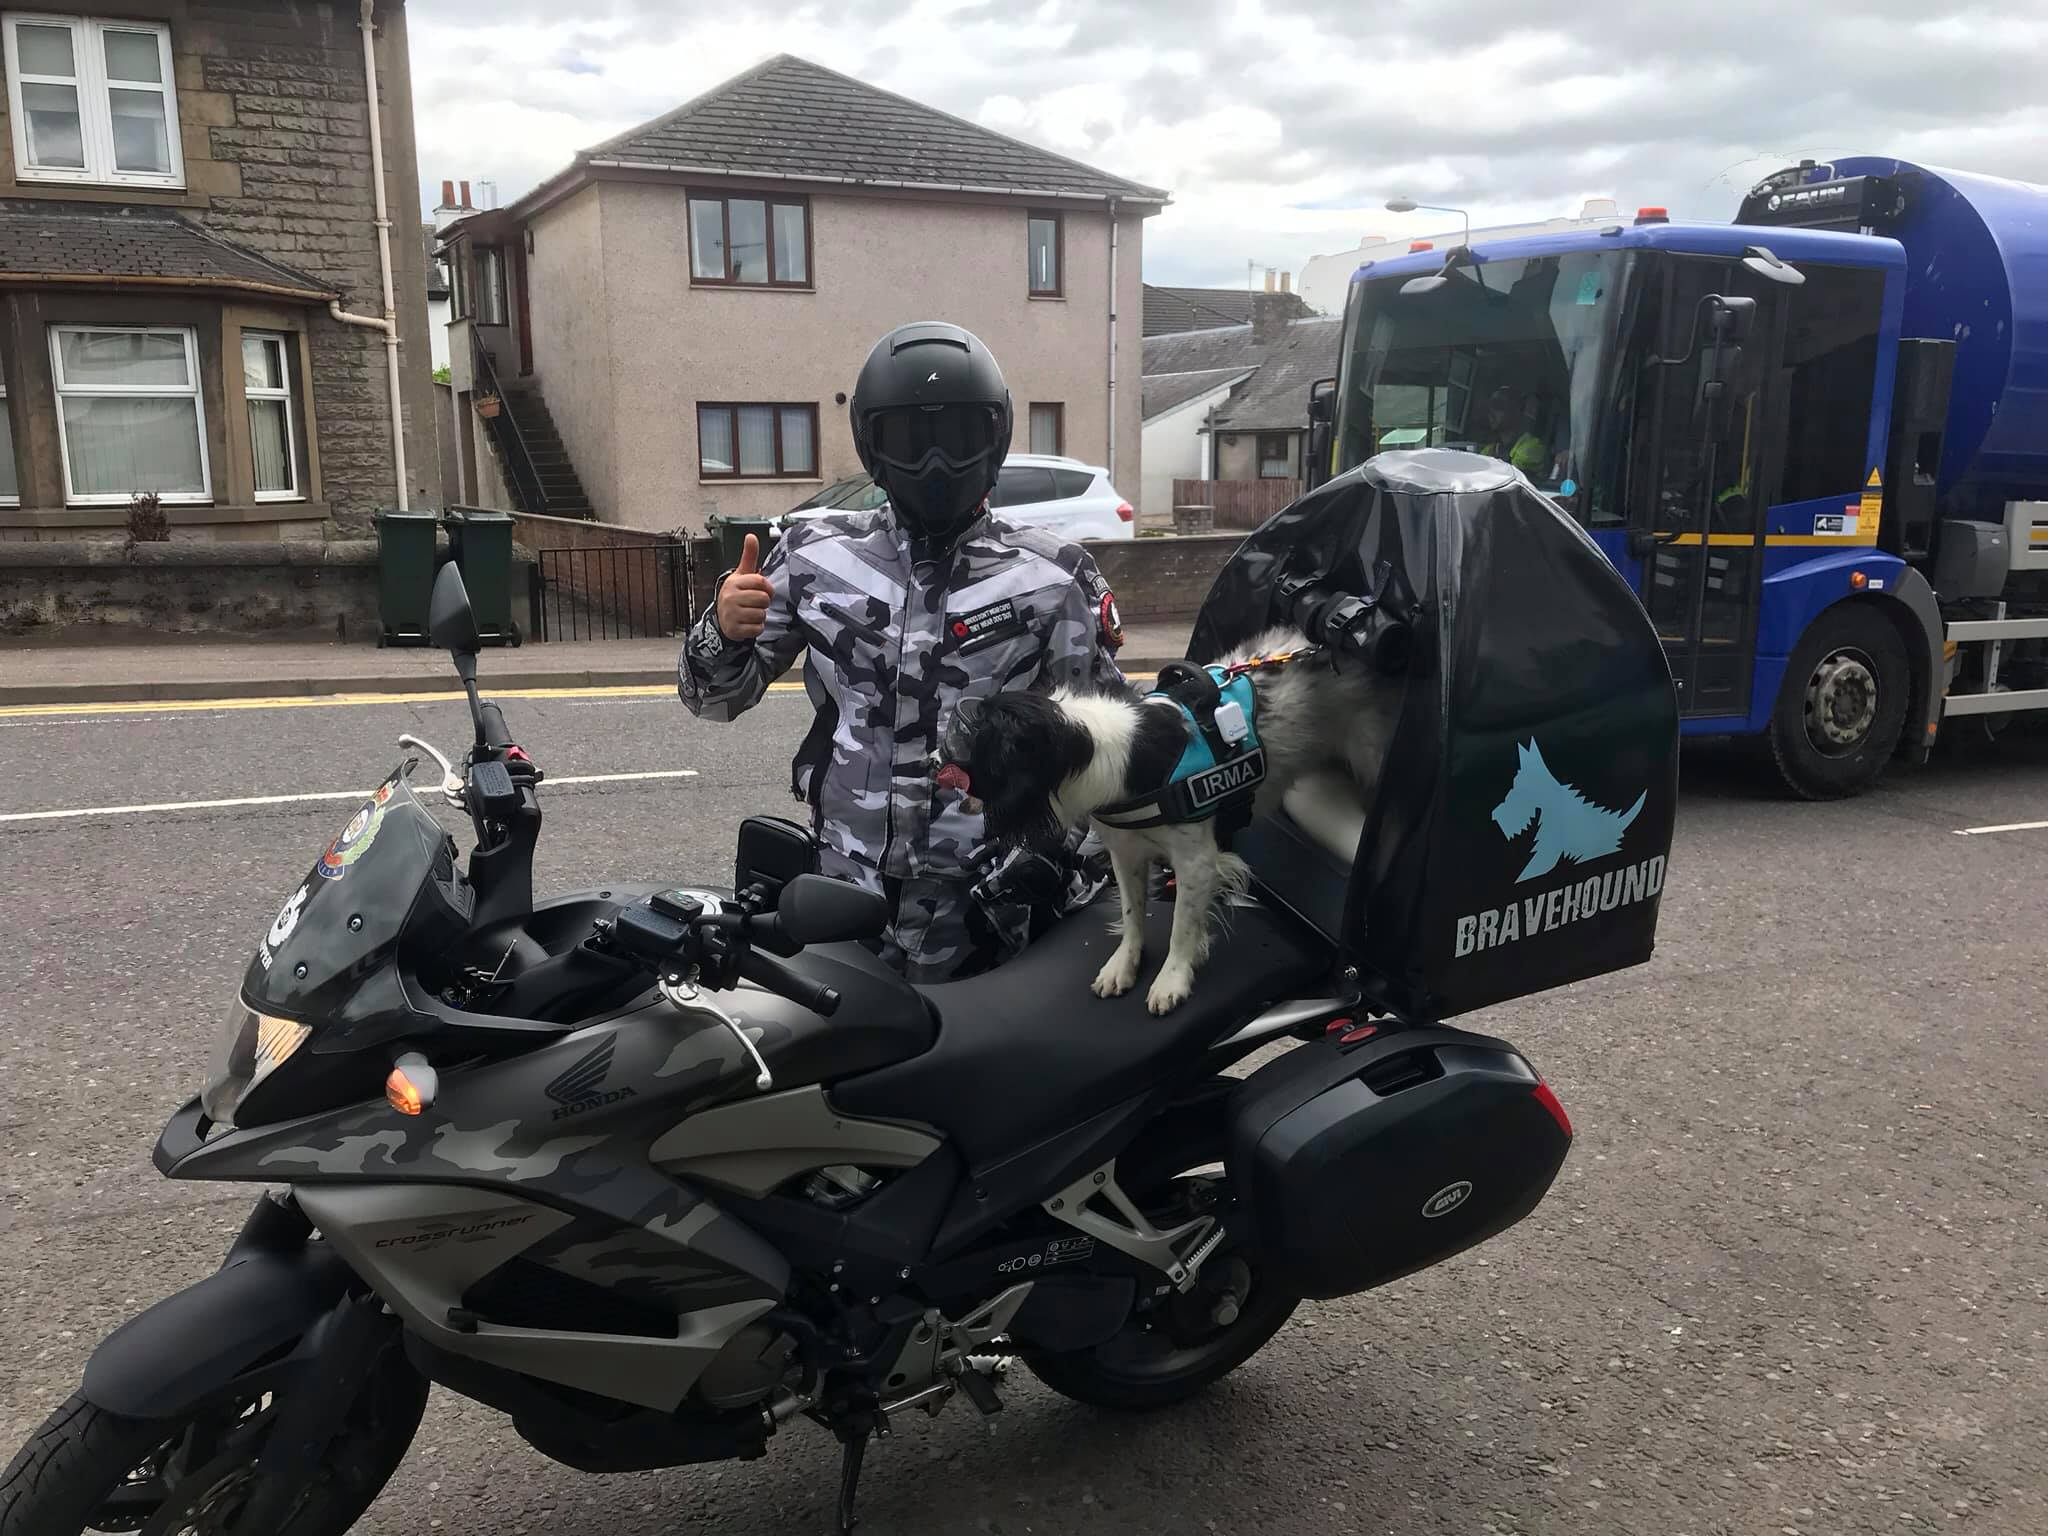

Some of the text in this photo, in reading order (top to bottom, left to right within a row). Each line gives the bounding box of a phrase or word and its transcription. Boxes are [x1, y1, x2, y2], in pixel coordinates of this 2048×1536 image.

[1202, 761, 1256, 797] IRMA
[1454, 854, 1666, 958] BRAVEHOUND
[552, 1086, 639, 1121] HONDA
[375, 1214, 537, 1249] crossrunner
